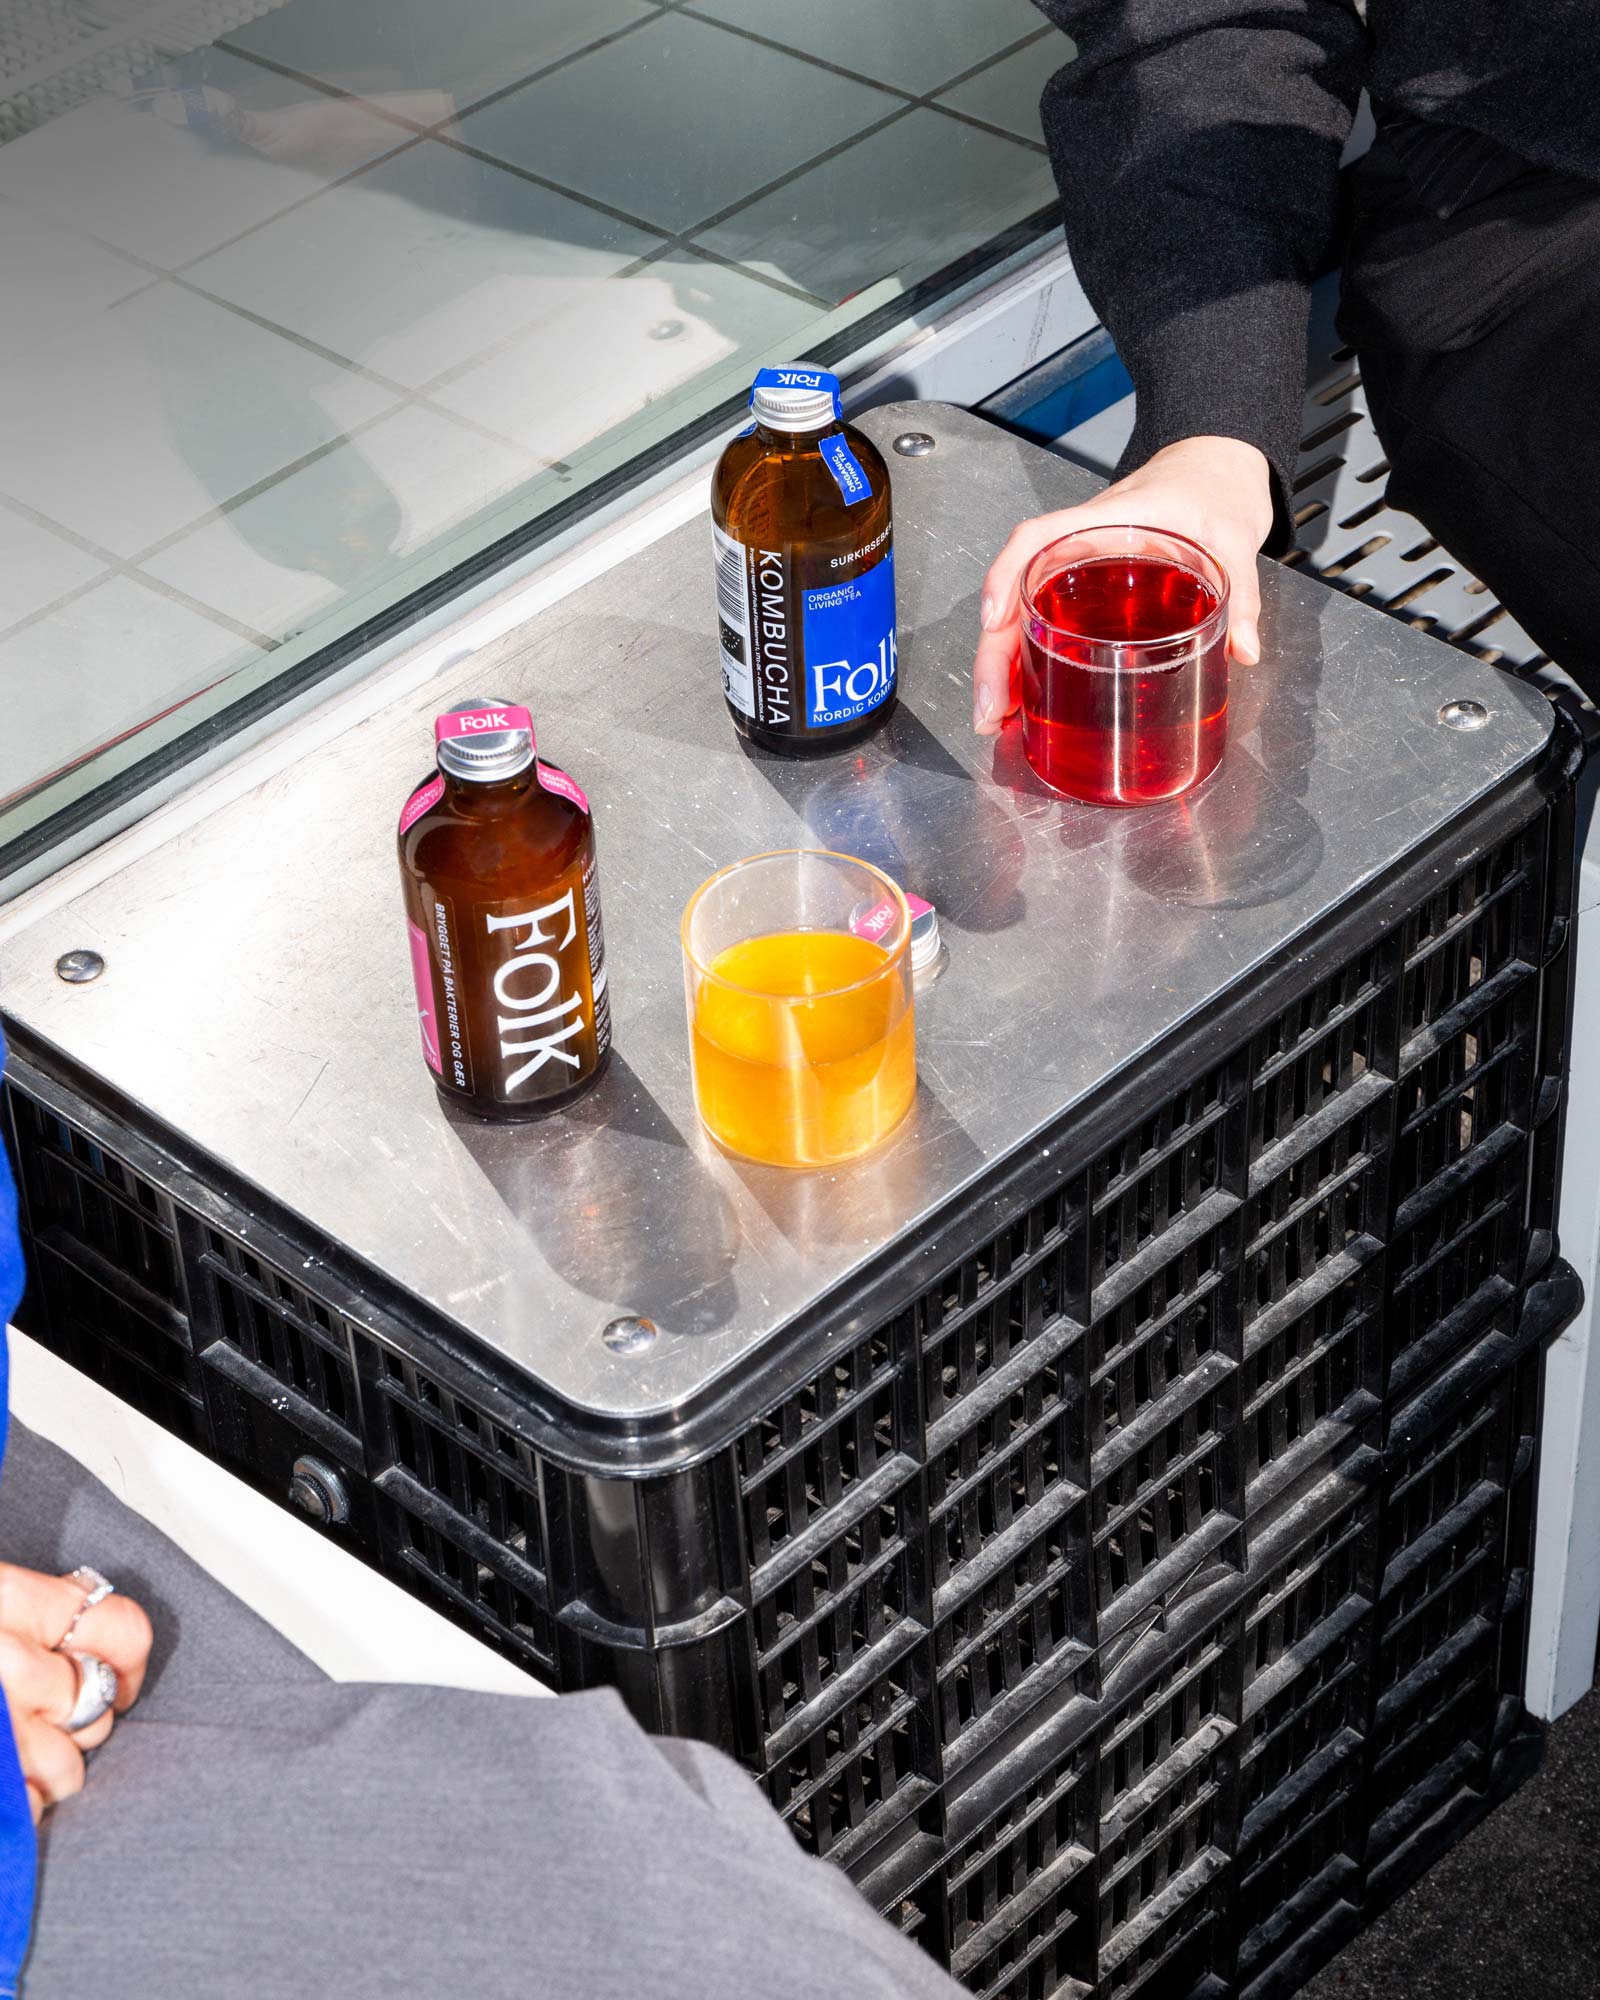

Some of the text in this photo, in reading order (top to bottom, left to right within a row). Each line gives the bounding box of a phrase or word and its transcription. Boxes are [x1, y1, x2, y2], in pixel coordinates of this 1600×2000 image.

[832, 455, 856, 493] ORGANIC
[835, 446, 863, 490] LIVING TEA
[808, 586, 854, 603] ORGANIC
[808, 590, 862, 611] LIVING TEA
[759, 549, 791, 724] KOMBUCHA
[813, 702, 865, 722] NORDIC
[434, 902, 465, 1087] BRYGGET PÅ BAKTERIER OG GÆR
